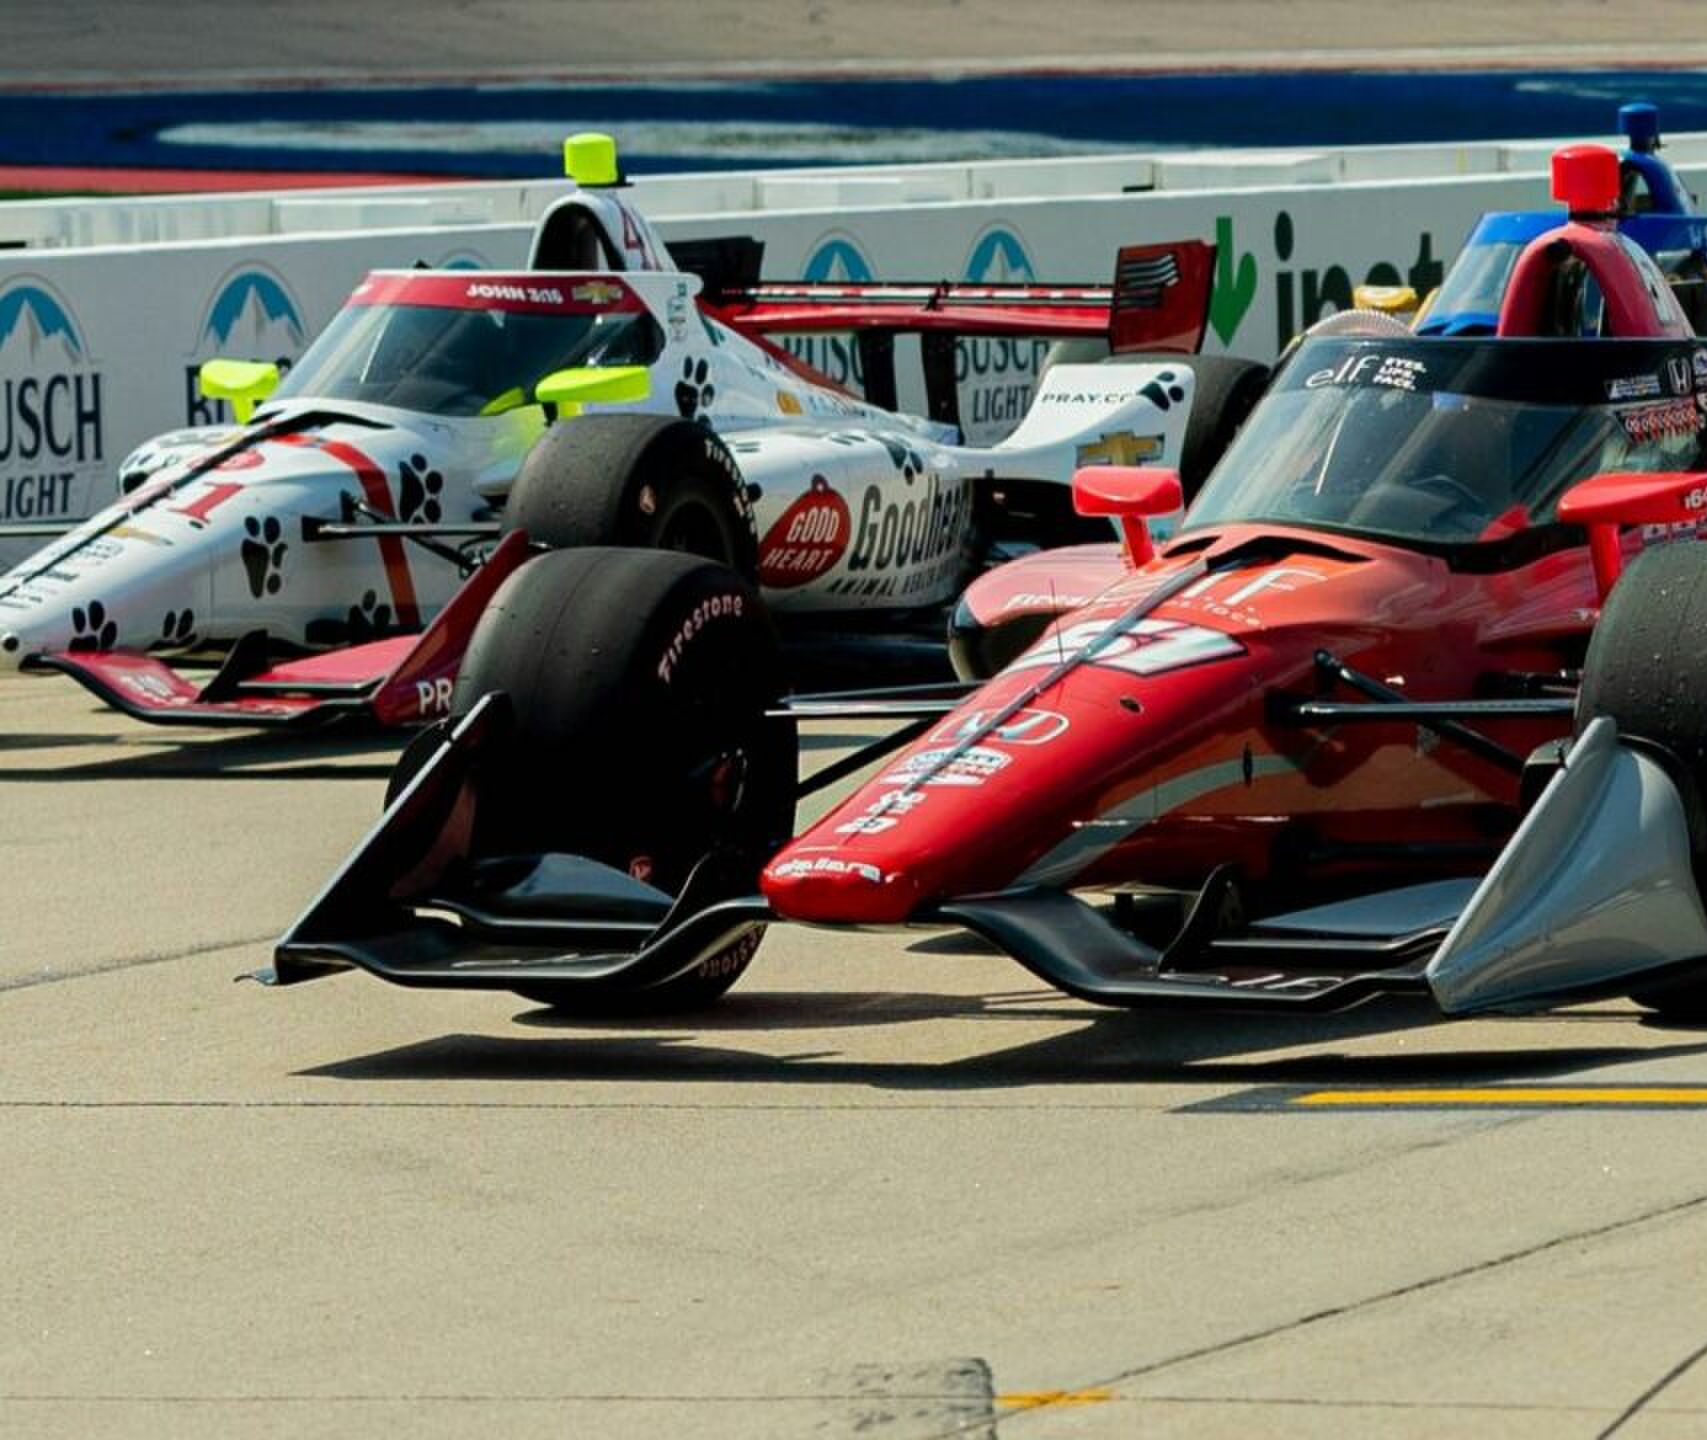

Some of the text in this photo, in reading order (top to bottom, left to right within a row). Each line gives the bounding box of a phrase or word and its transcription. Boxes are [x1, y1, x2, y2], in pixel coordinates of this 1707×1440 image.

[466, 282, 525, 301] JOHN
[0, 371, 103, 462] SCH
[971, 386, 1031, 423] LIGHT
[4, 471, 75, 520] IGHT
[786, 507, 841, 544] GOOD
[762, 548, 834, 573] HEART
[656, 594, 744, 684] Firestone
